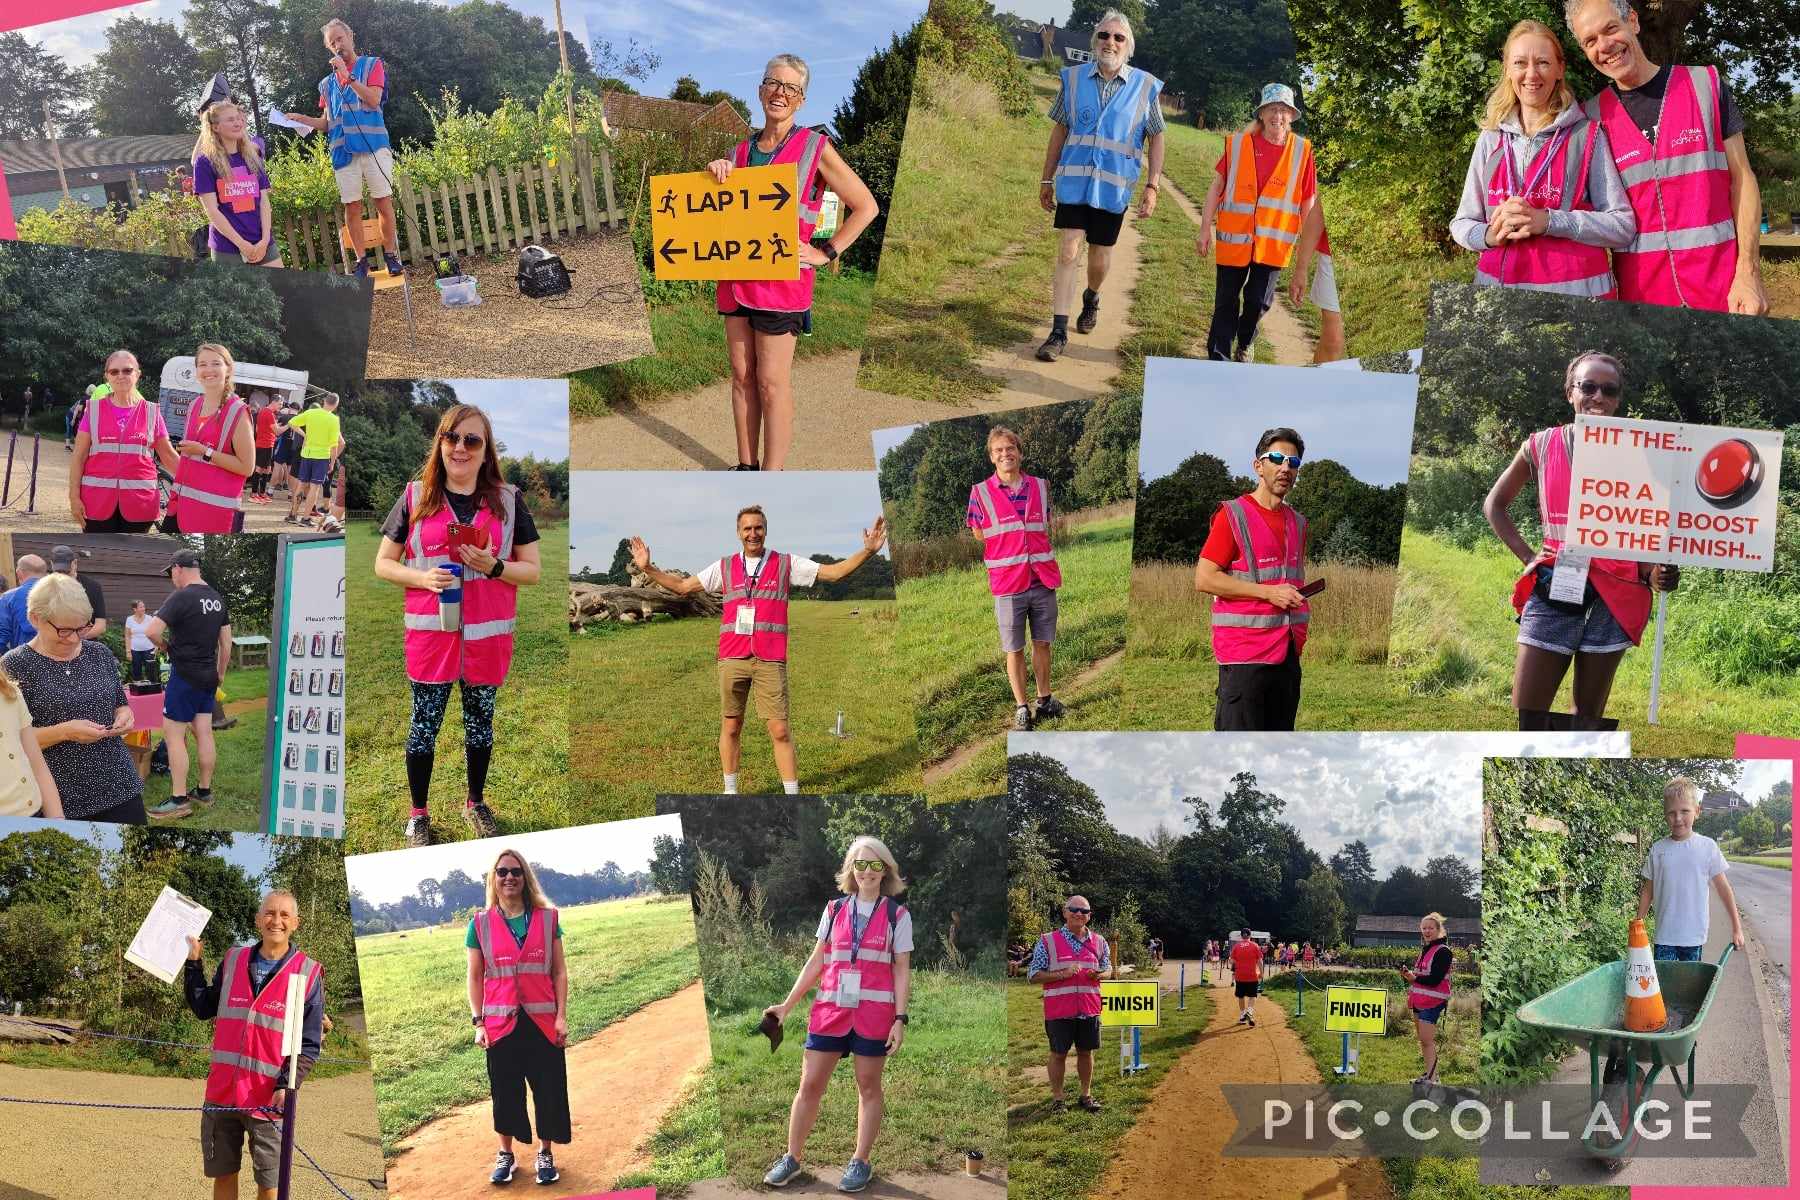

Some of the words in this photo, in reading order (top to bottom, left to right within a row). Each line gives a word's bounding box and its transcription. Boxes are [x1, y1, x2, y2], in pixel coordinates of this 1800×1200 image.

[686, 190, 734, 213] LAP
[739, 189, 750, 210] 1
[693, 240, 741, 261] LAP
[747, 239, 763, 260] 2
[1584, 426, 1623, 445] HIT
[1630, 430, 1693, 452] THE...
[1581, 478, 1630, 498] FOR
[1636, 483, 1653, 501] A
[1579, 503, 1670, 527] POWER
[1677, 512, 1759, 535] BOOST
[1577, 527, 1608, 546] TO
[1615, 531, 1661, 552] THE
[1668, 536, 1762, 561] FINISH...
[200, 598, 222, 615] 100
[1100, 996, 1154, 1012] FINISH
[1330, 1001, 1383, 1019] FINISH
